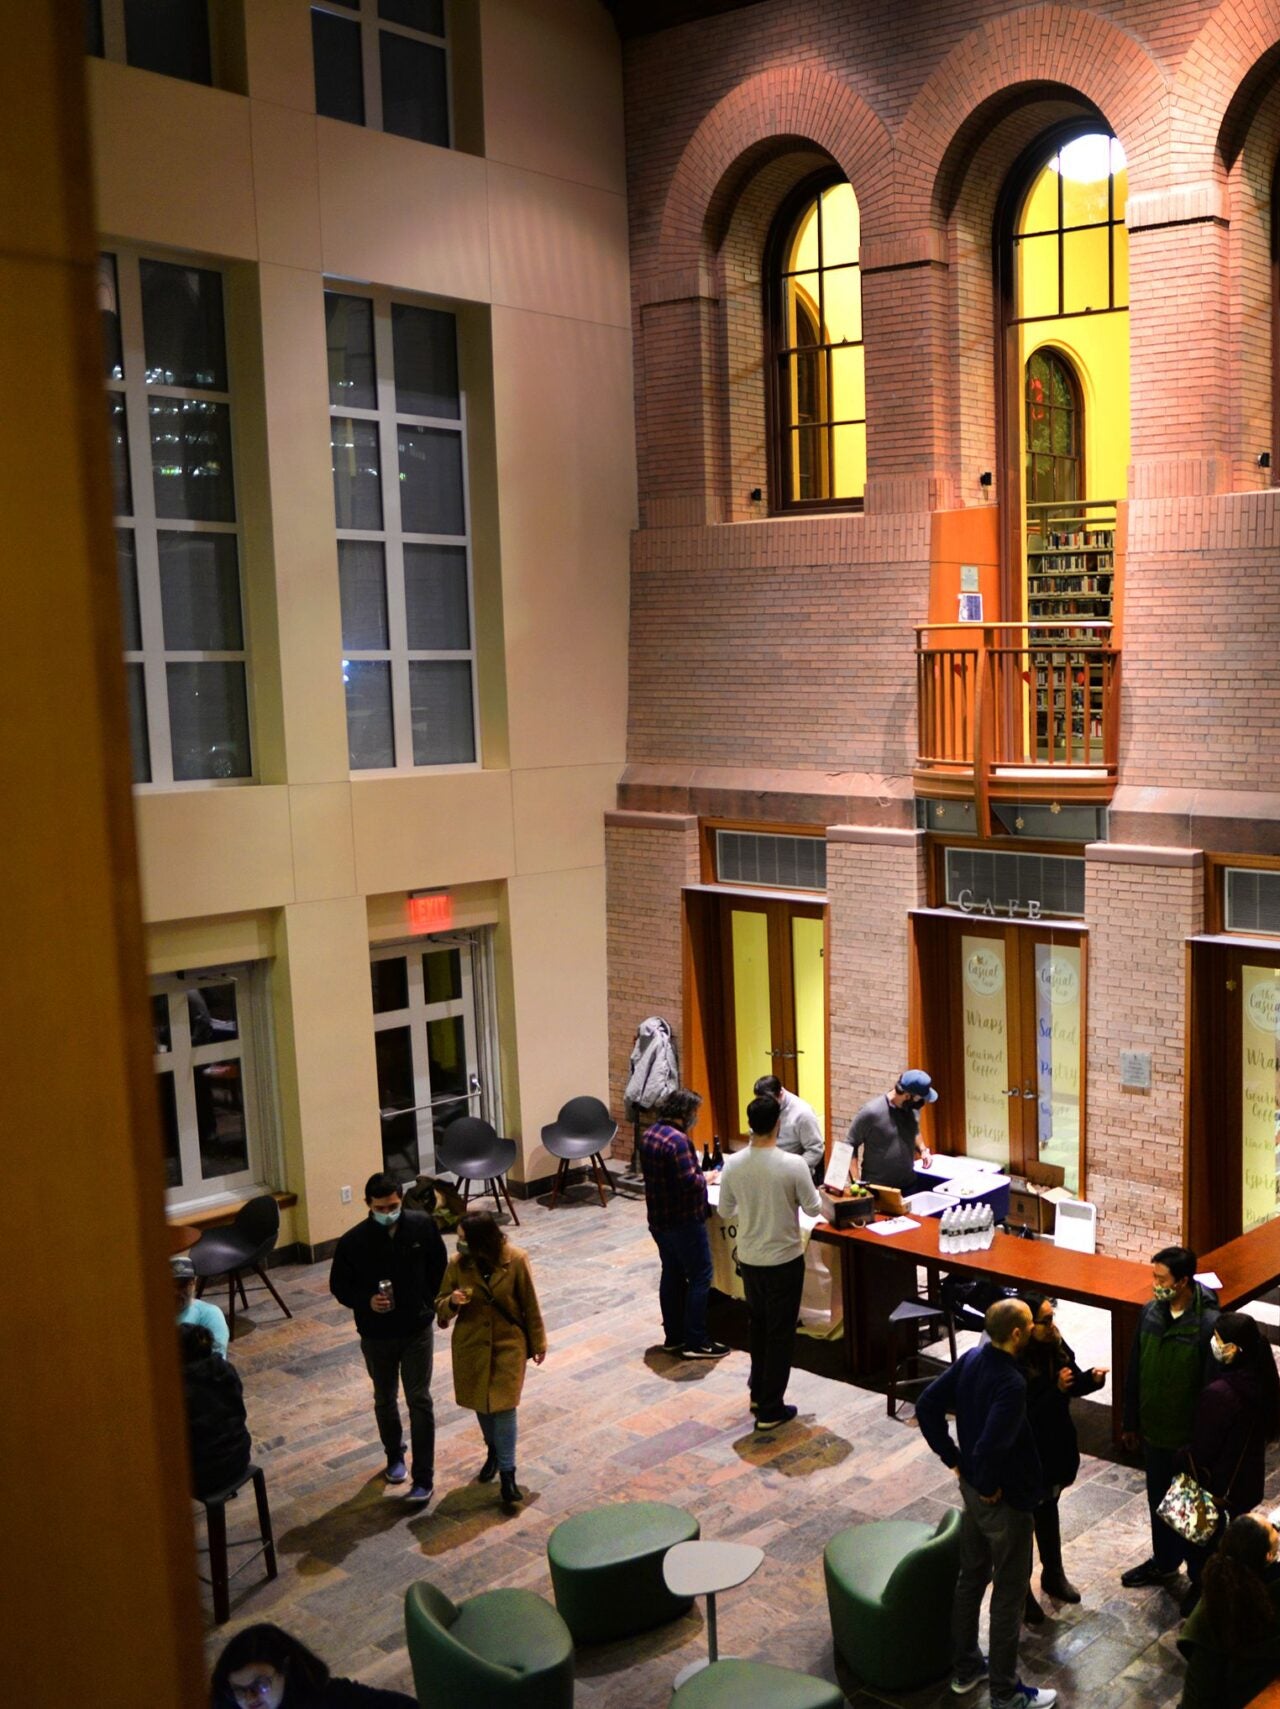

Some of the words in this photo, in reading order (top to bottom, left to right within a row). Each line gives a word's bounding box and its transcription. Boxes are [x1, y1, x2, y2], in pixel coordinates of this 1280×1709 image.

[958, 889, 1041, 919] CAFE
[966, 1010, 1003, 1034] Wraps
[1039, 1018, 1077, 1045] Salad
[1040, 1060, 1078, 1087] Pastry
